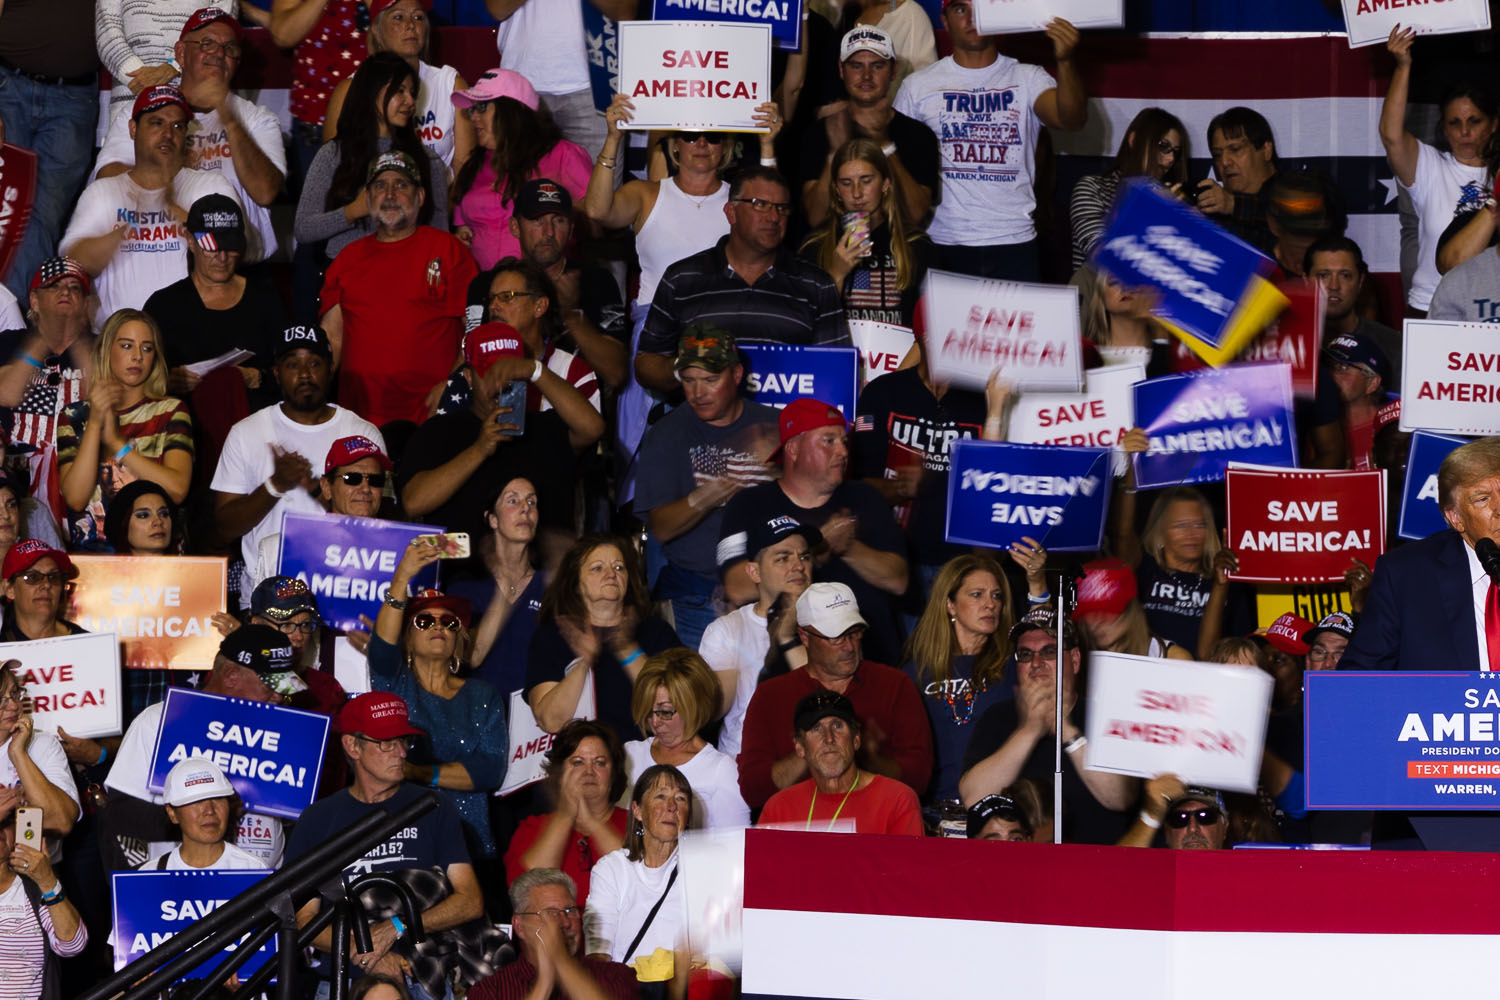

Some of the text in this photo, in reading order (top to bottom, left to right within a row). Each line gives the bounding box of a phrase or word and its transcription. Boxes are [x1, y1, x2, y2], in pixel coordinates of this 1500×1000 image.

[662, 50, 729, 69] SAVE
[632, 79, 758, 100] AMERICA!
[943, 90, 1014, 114] TRUMP
[967, 112, 992, 123] SAVE
[941, 121, 1022, 146] AMERICA
[952, 142, 1008, 165] RALLY
[117, 207, 176, 226] KRISTIN
[283, 325, 318, 343] USA
[479, 338, 519, 354] TRUMP
[746, 373, 815, 394] SAVE
[1036, 399, 1107, 428] SAVE
[1174, 394, 1249, 424] SAVE
[990, 503, 1064, 526] SAVE
[1267, 500, 1339, 523] SAVE
[1238, 529, 1371, 553] AMERICA!
[324, 543, 398, 573] SAVE
[108, 583, 181, 608] SAVE
[238, 650, 253, 665] 45
[270, 645, 293, 659] TRU
[13, 664, 74, 687] AVE
[206, 720, 281, 752] SAVE
[1422, 746, 1481, 756] PRESIDENT
[168, 742, 307, 788] AMERICA!
[1415, 764, 1449, 775] TEXT
[1434, 784, 1498, 796] WARREN,
